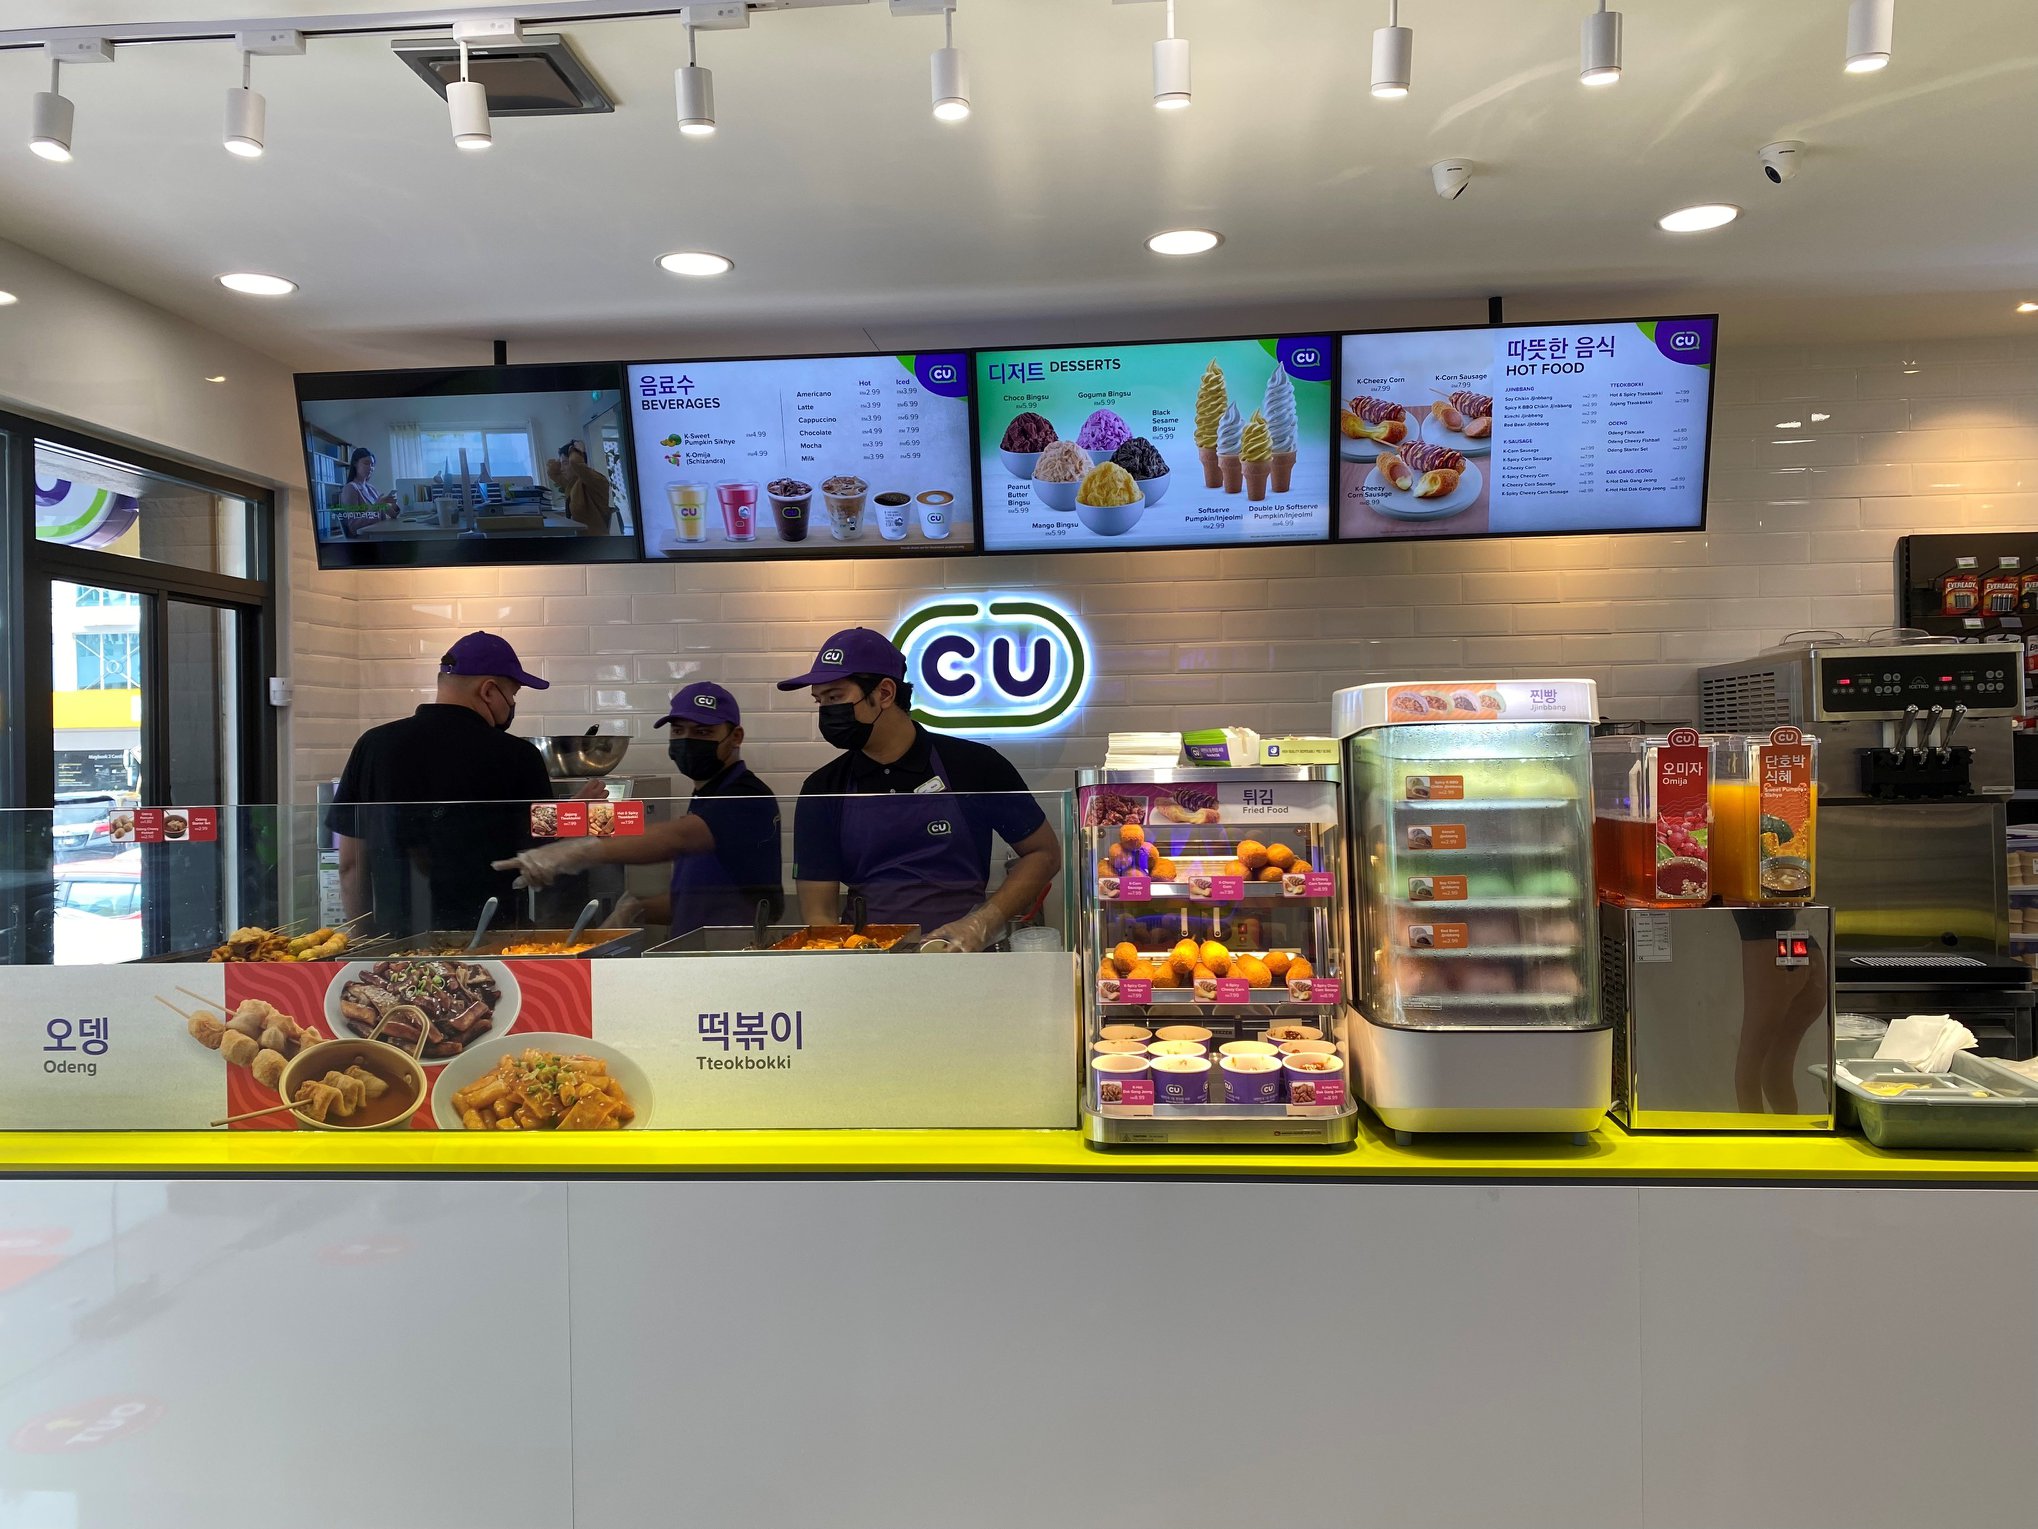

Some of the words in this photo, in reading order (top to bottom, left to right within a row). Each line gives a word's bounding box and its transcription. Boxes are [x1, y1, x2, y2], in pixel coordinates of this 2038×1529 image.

[1676, 336, 1695, 346] CU
[1508, 337, 1568, 361] 따뜻한
[1575, 336, 1615, 358] 음식
[1296, 353, 1315, 363] CU
[1050, 358, 1121, 373] DESSERTS
[1506, 364, 1537, 376] HOT
[1542, 362, 1585, 375] FOOD
[933, 369, 952, 379] CU
[989, 362, 1045, 384] 디저트
[640, 375, 695, 397] 음료수
[1026, 394, 1049, 402] Bingsu
[1108, 390, 1132, 398] Bingsu
[642, 397, 720, 410] BEVERAGES
[798, 416, 837, 424] Cappuccino
[799, 429, 832, 437] Chocolate
[1152, 425, 1176, 433] Bingsu
[686, 458, 726, 466] (Schizandra)
[680, 506, 698, 518] CU
[1947, 581, 1976, 589] EVEREADY
[1986, 582, 2017, 590] EVEREADY
[825, 652, 840, 661] CU
[921, 635, 1051, 697] CU
[698, 697, 713, 705] CU
[1530, 689, 1557, 703] 찐빵
[1530, 704, 1566, 712] Jjinbbang
[1676, 733, 1692, 743] CU
[1777, 732, 1794, 742] CU
[1765, 754, 1806, 769] 단호박
[1662, 761, 1703, 777] 오미자
[1662, 777, 1688, 786] Omija
[1765, 770, 1792, 784] 식혜
[1242, 789, 1273, 805] 튀김
[1242, 806, 1265, 814] Fried
[1267, 806, 1289, 814] Food
[931, 823, 946, 832] CU
[43, 1017, 108, 1055] 오뎅
[698, 1011, 802, 1051] 떡볶이
[696, 1055, 791, 1069] Tteokbokki
[44, 1060, 97, 1076] Odeng
